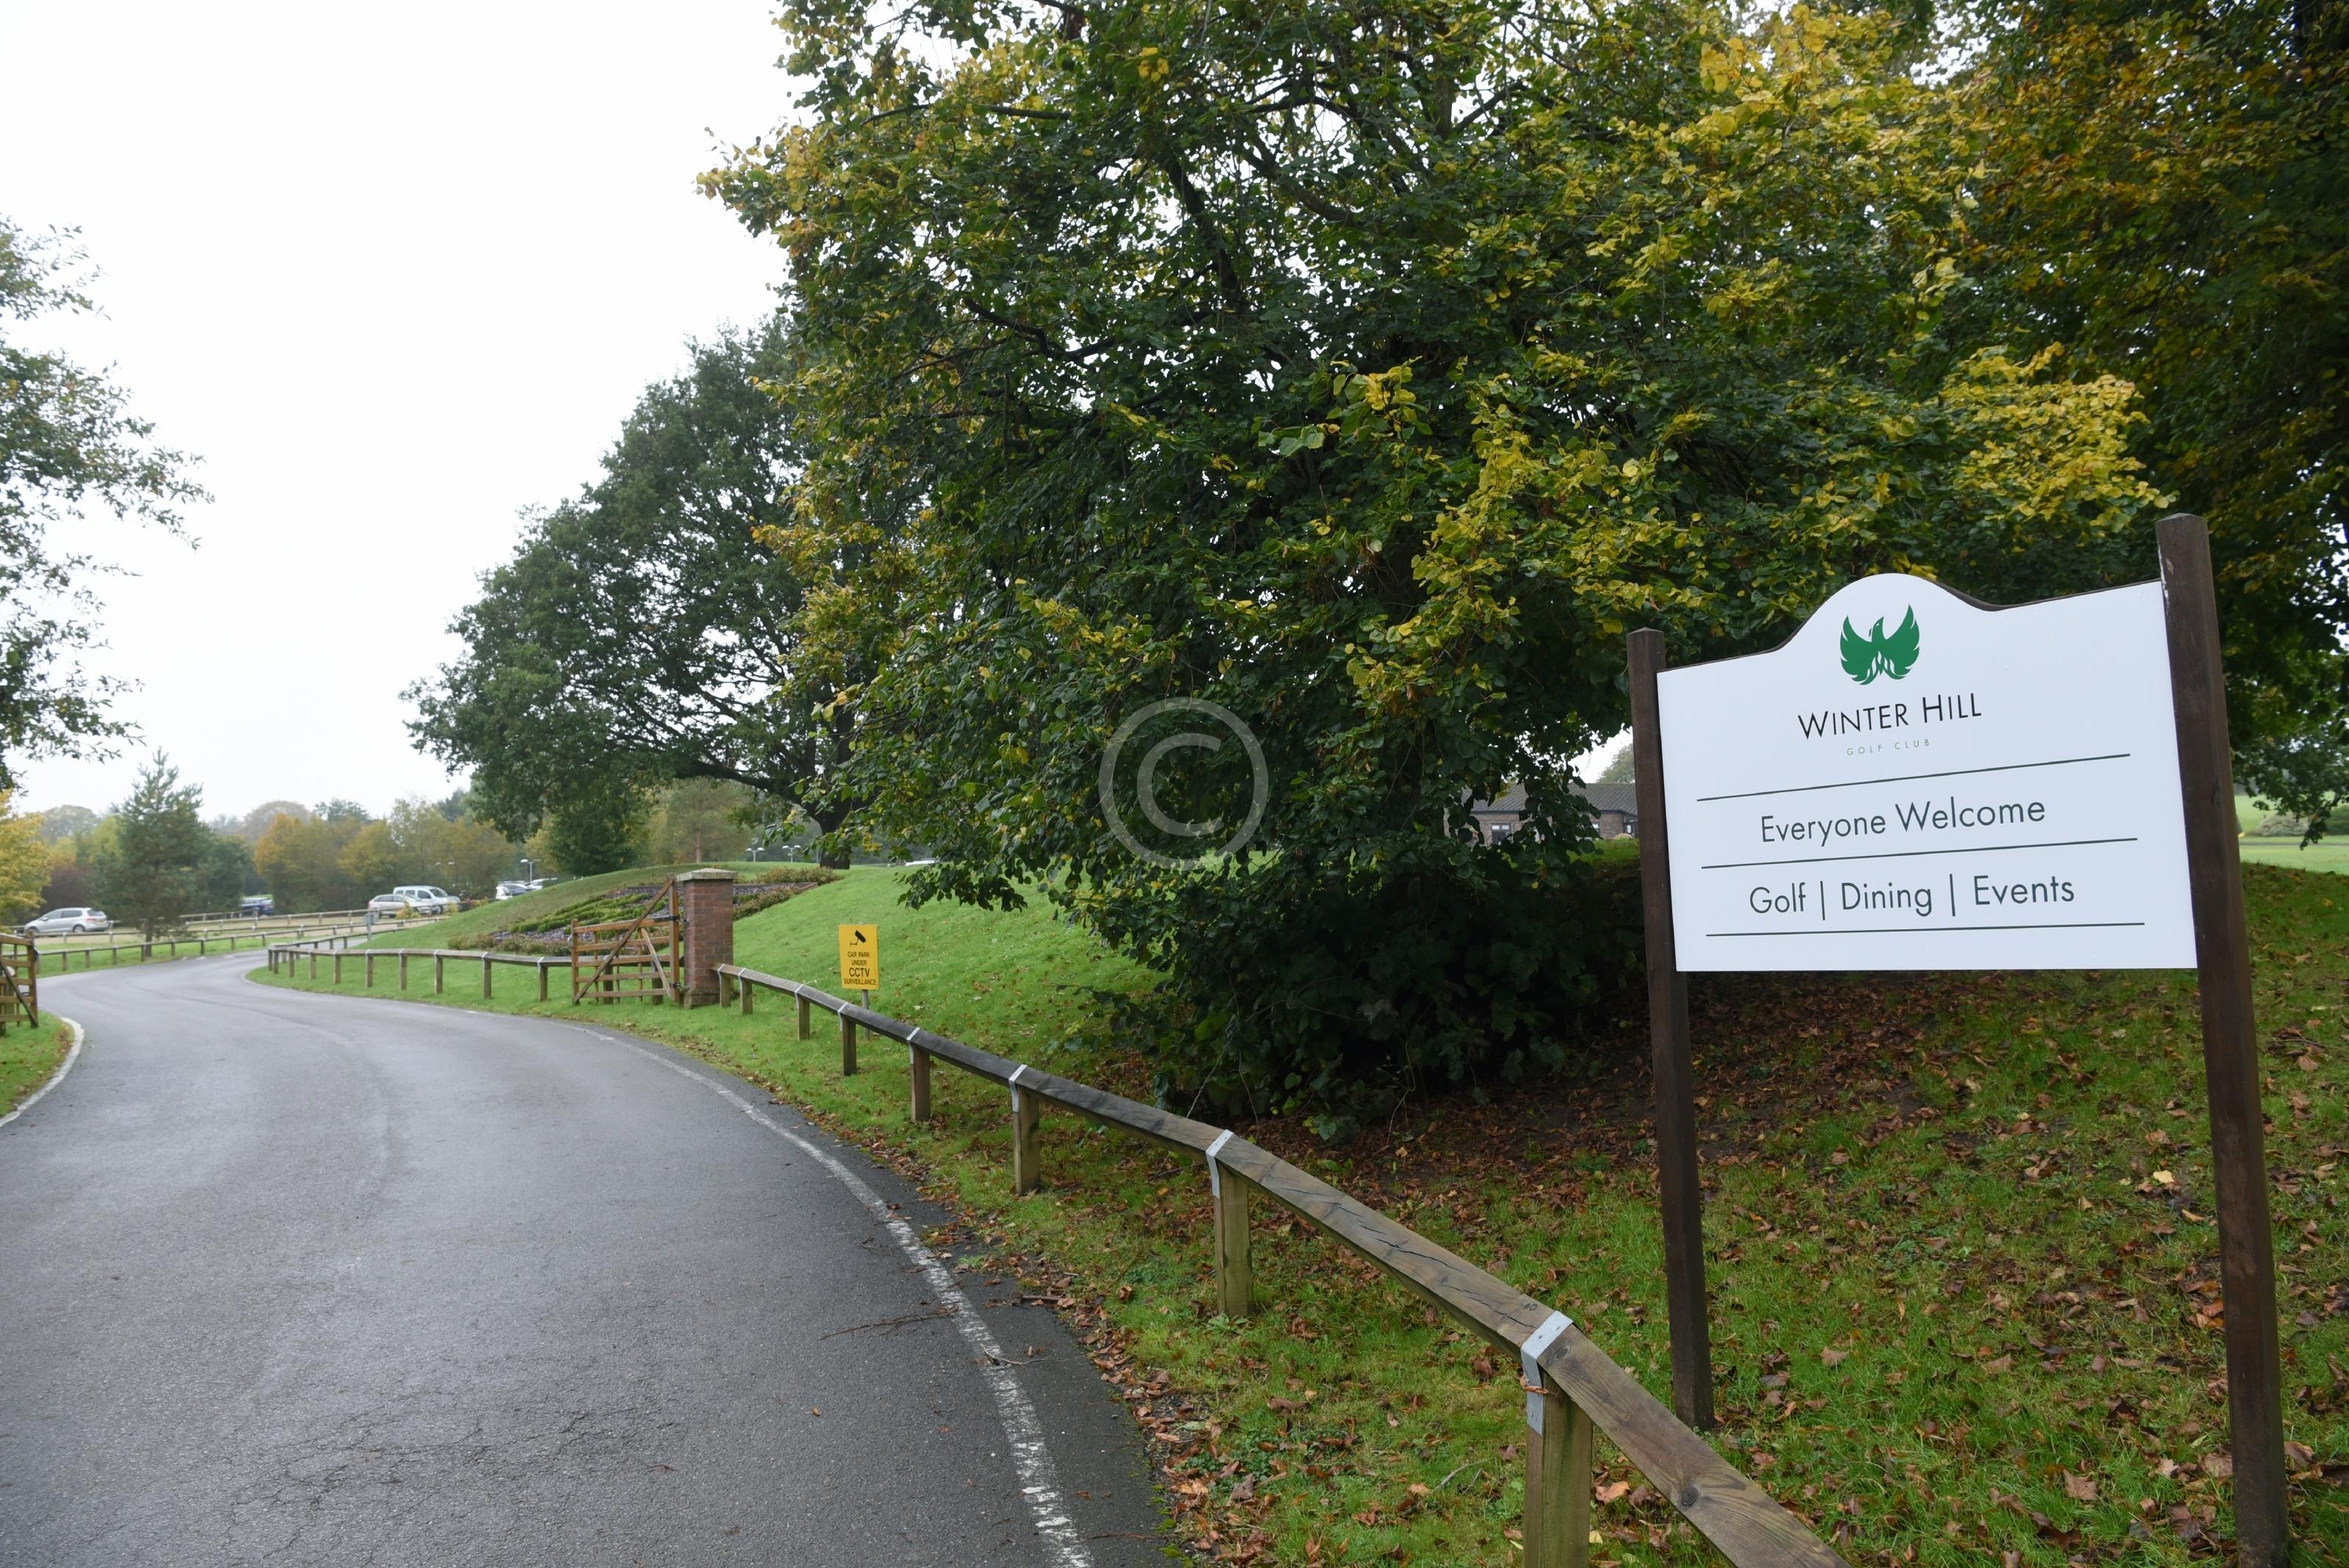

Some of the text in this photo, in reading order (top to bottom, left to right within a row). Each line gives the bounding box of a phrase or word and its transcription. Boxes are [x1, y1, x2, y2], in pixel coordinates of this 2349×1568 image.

[1797, 692, 1982, 741] WINTER HILL
[1846, 738, 1932, 756] GOLF CLUB
[1761, 796, 2046, 848] Everyone Welcome
[1749, 881, 1807, 914] Golf
[1840, 882, 1933, 918] Dining
[1973, 874, 2074, 906] Events
[849, 968, 870, 977] CCTV
